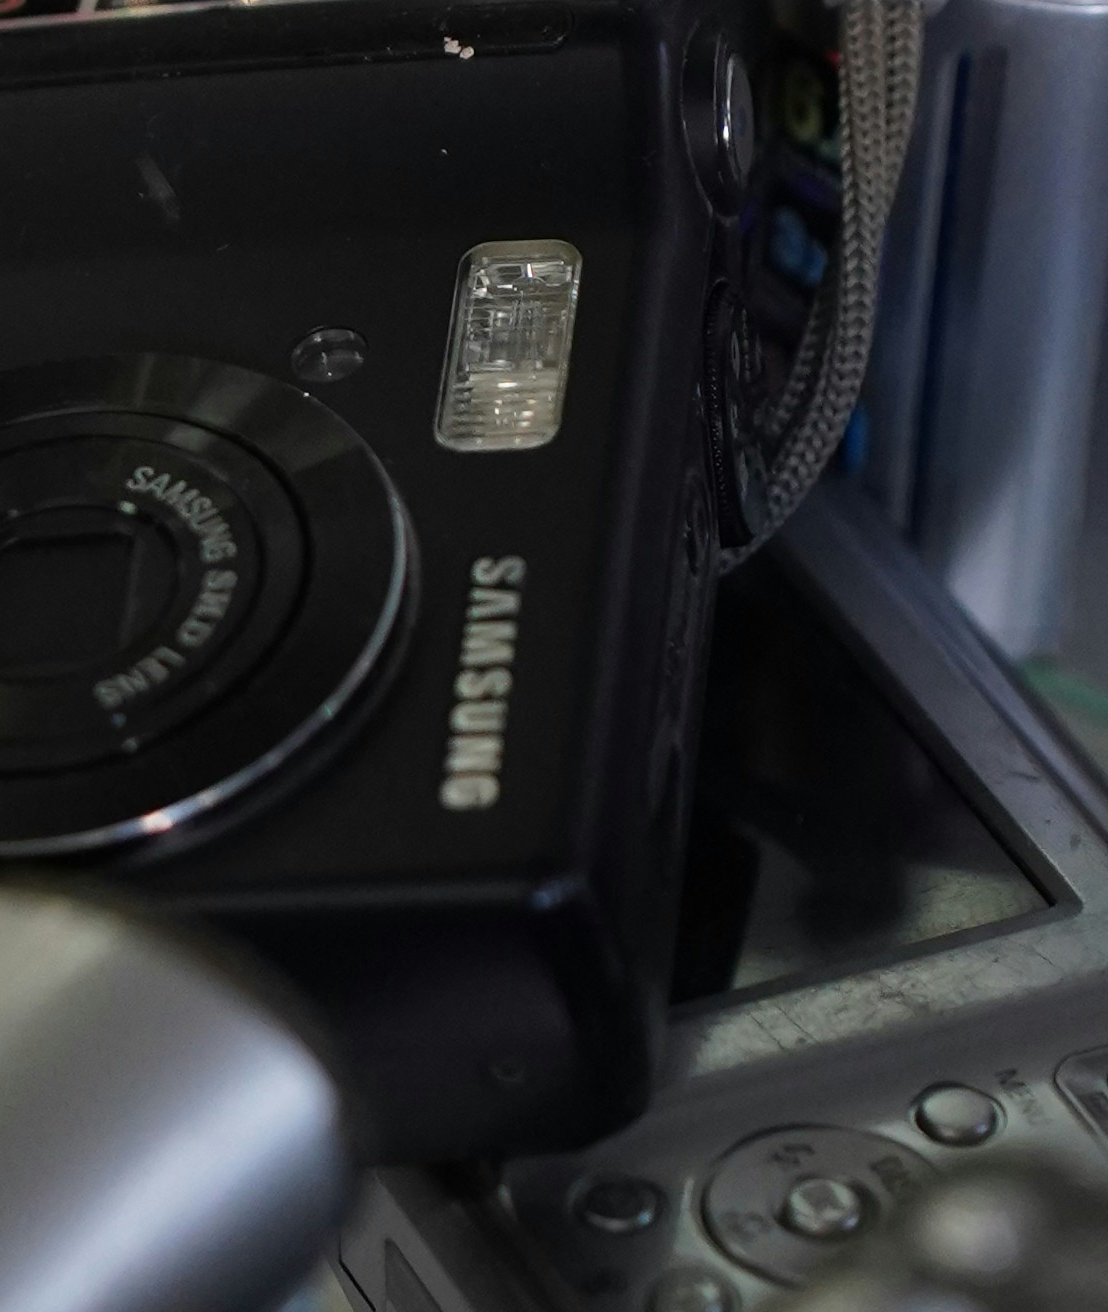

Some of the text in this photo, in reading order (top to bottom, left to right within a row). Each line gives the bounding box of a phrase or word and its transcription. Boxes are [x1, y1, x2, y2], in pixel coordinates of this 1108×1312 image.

[124, 465, 238, 564] SAMSUNG
[92, 645, 185, 710] LENS
[437, 556, 527, 811] SAMSUNG
